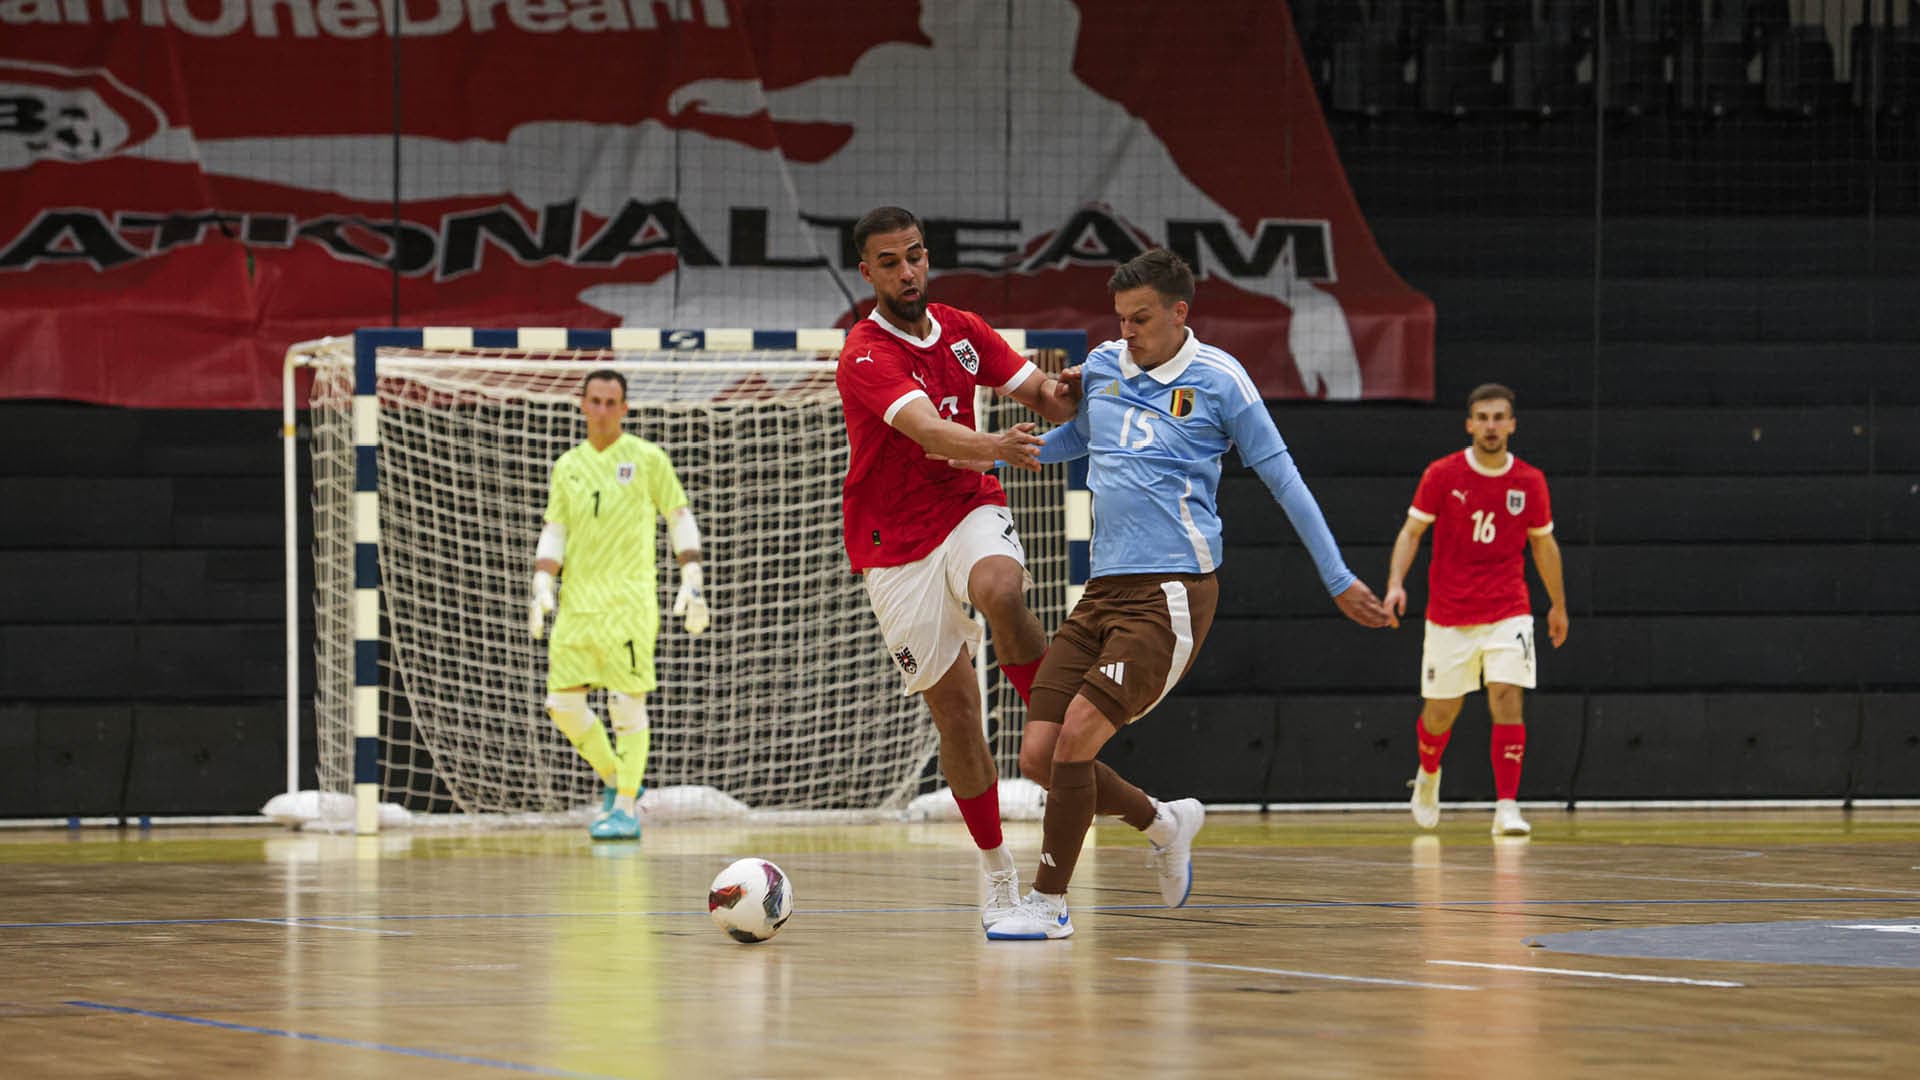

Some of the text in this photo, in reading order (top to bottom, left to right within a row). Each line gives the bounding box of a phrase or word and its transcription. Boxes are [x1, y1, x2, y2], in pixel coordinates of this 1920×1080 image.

[1119, 406, 1161, 449] 15
[591, 490, 600, 518] 1
[1470, 509, 1497, 544] 16
[623, 639, 636, 669] 1
